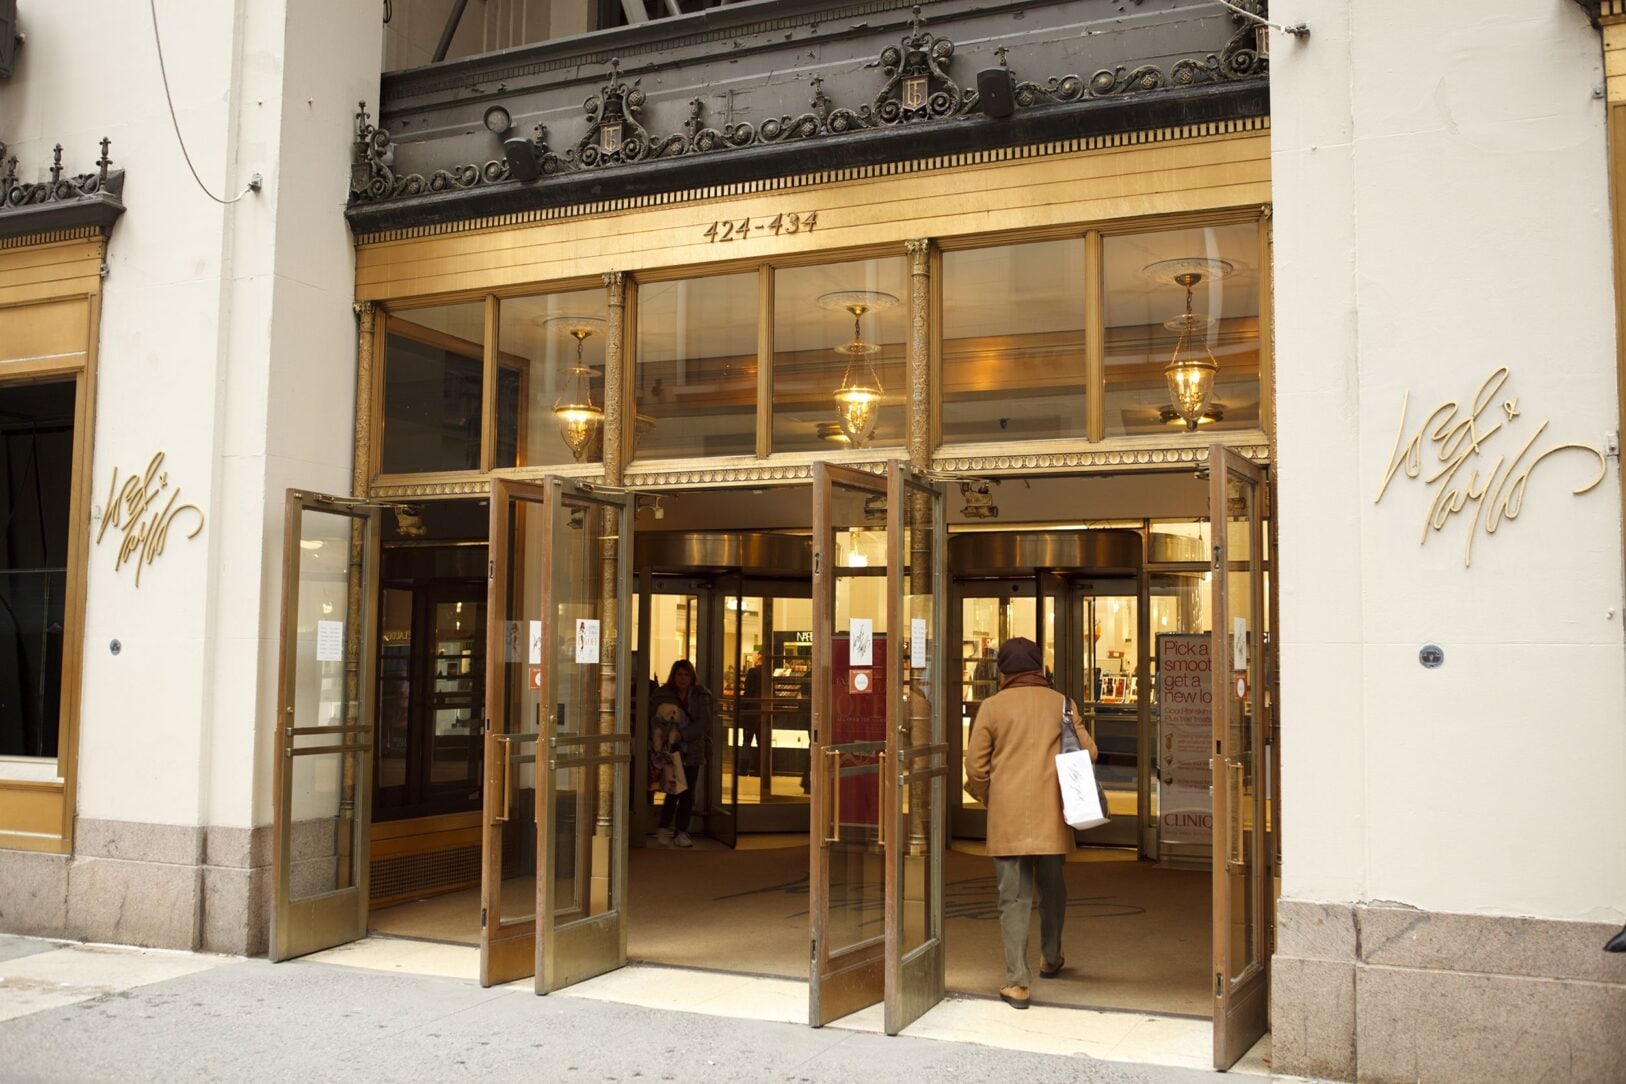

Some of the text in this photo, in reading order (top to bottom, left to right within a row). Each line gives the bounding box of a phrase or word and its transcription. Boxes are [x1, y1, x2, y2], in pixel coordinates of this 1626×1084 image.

[703, 210, 818, 244] 424-434
[1164, 640, 1209, 656] Pick a
[1164, 658, 1212, 672] smoot
[1164, 673, 1201, 691] get a
[1164, 691, 1197, 704] new
